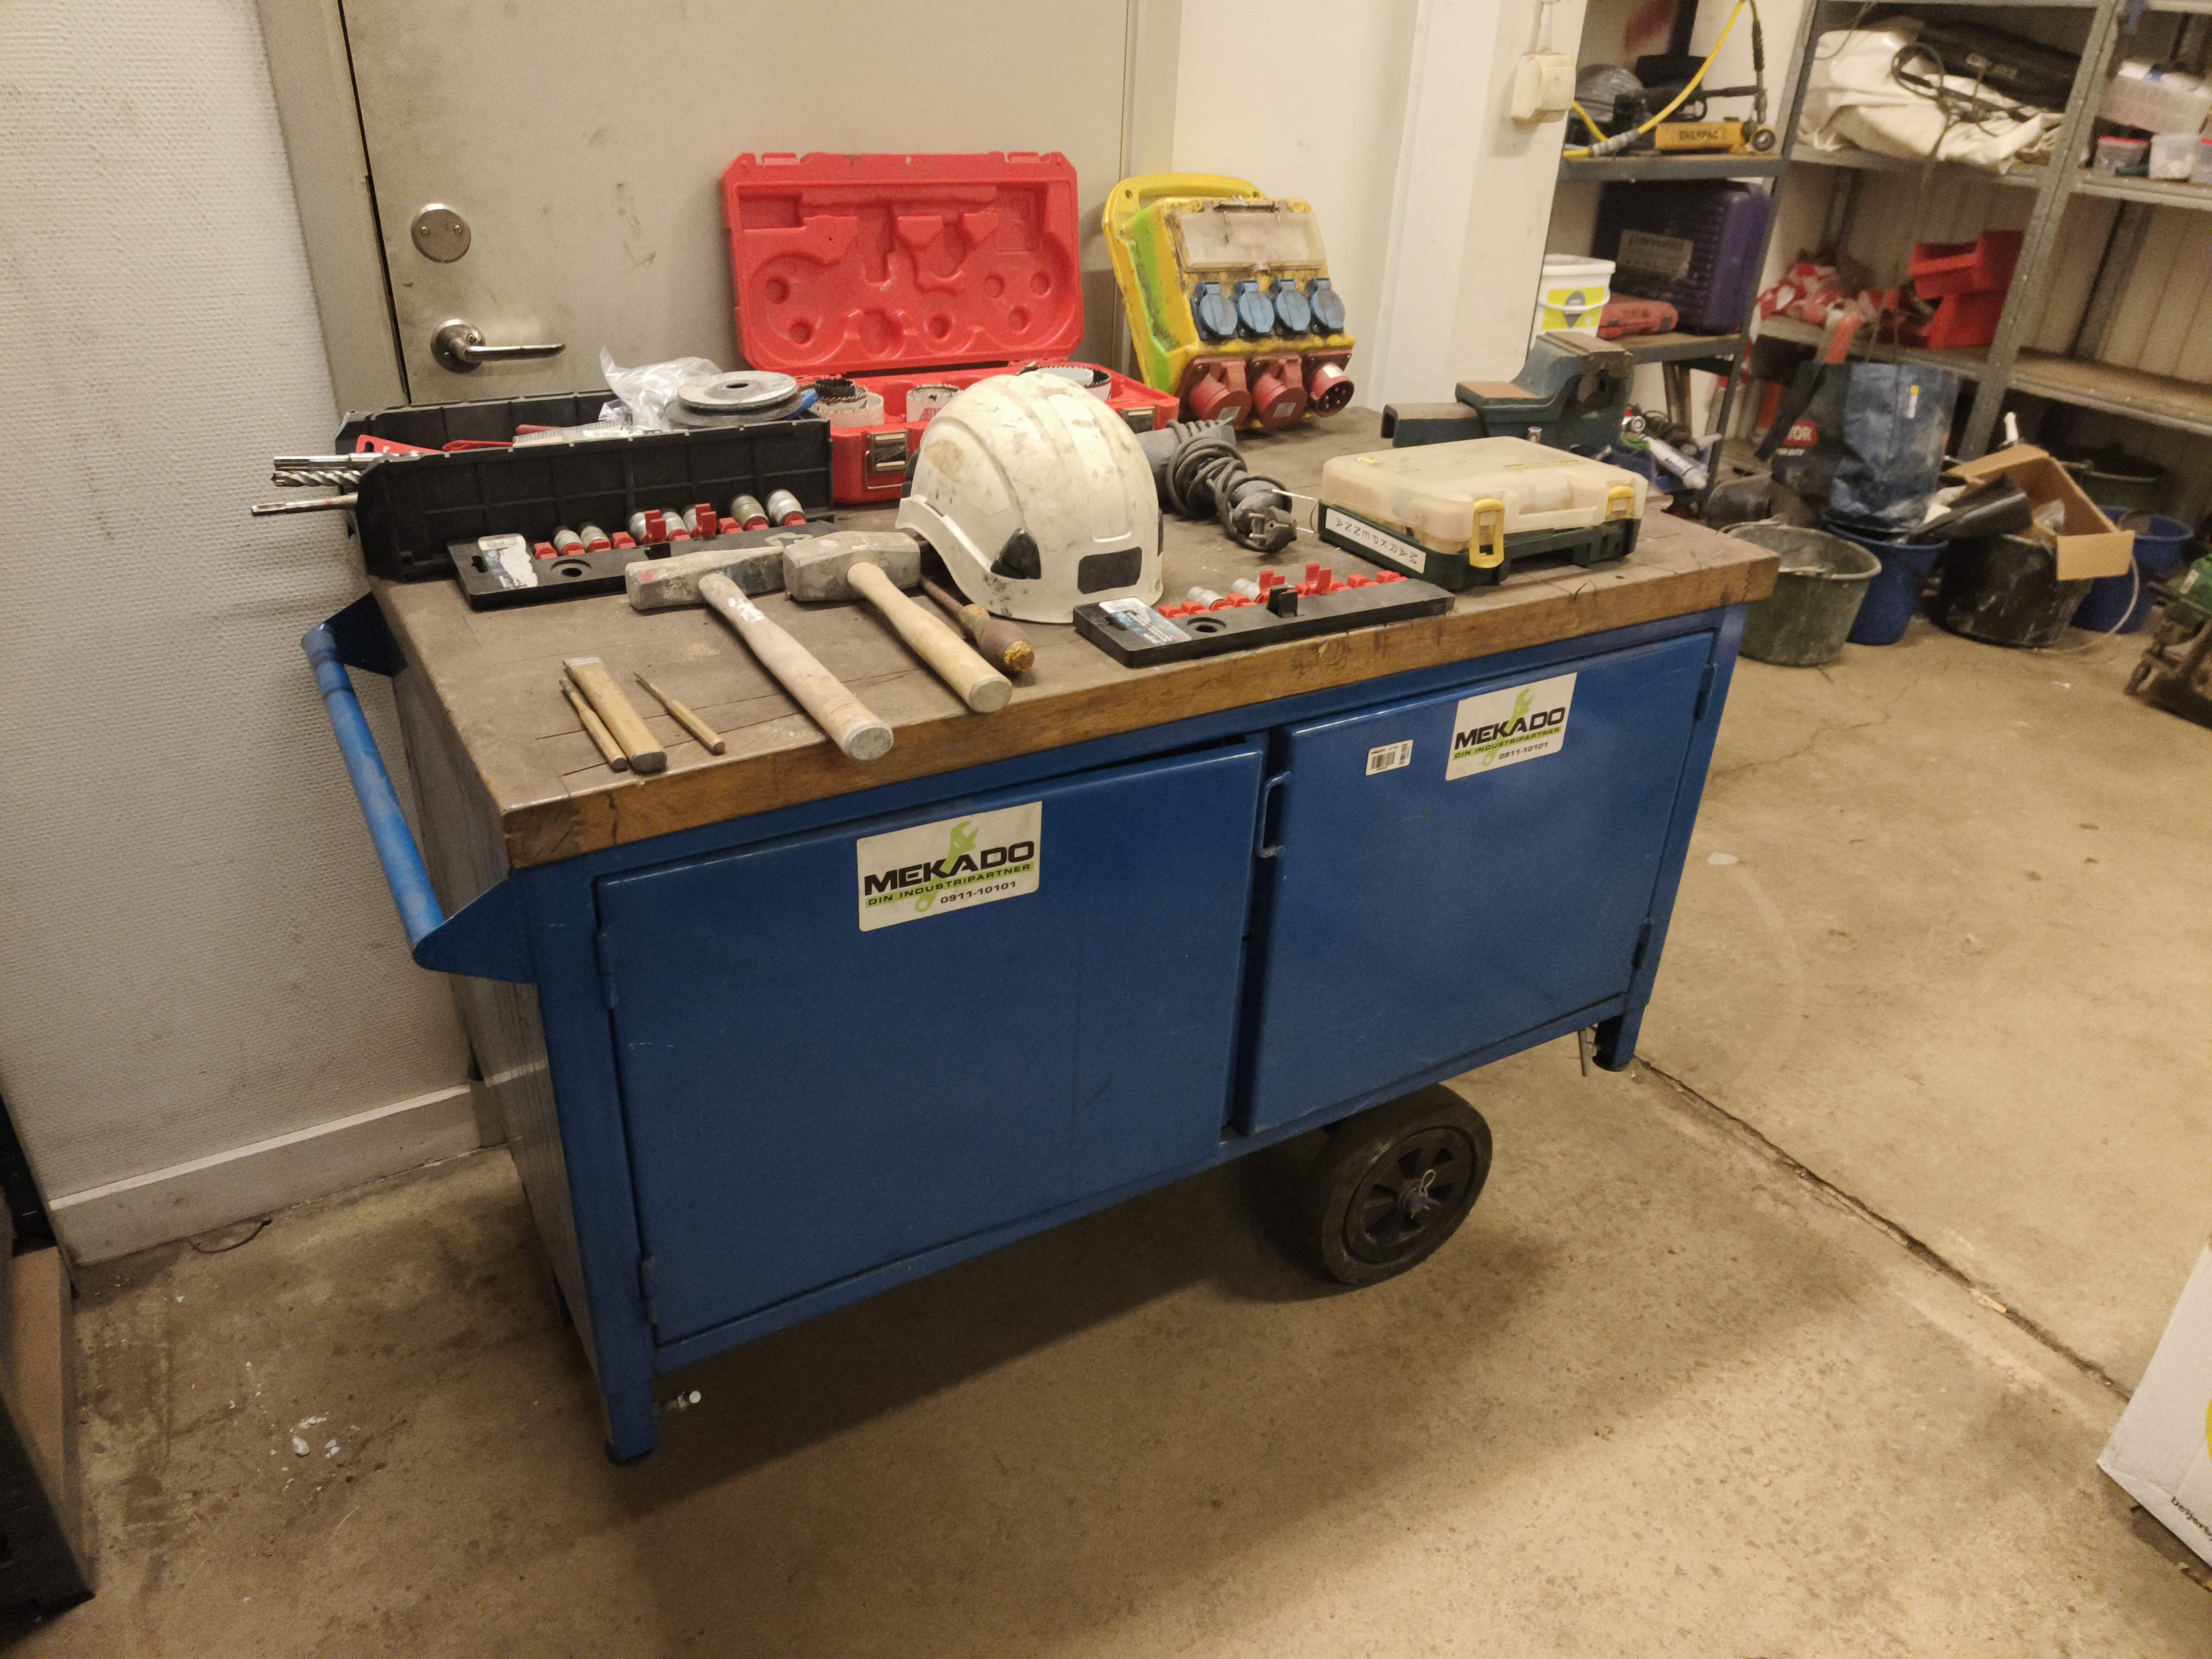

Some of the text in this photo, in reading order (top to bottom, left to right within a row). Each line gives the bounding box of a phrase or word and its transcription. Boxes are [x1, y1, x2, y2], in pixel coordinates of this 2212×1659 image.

[1336, 517, 1418, 564] MARKPENNA
[1454, 707, 1566, 750] MEKADO
[1454, 727, 1560, 759] DIN INDUSTRIPARTNER
[1498, 741, 1549, 760] 0911-10101
[864, 841, 1034, 896] MEKADO
[868, 864, 1030, 906] DIN INDUSTRIPARTNER
[940, 881, 1016, 903] 0911-10101
